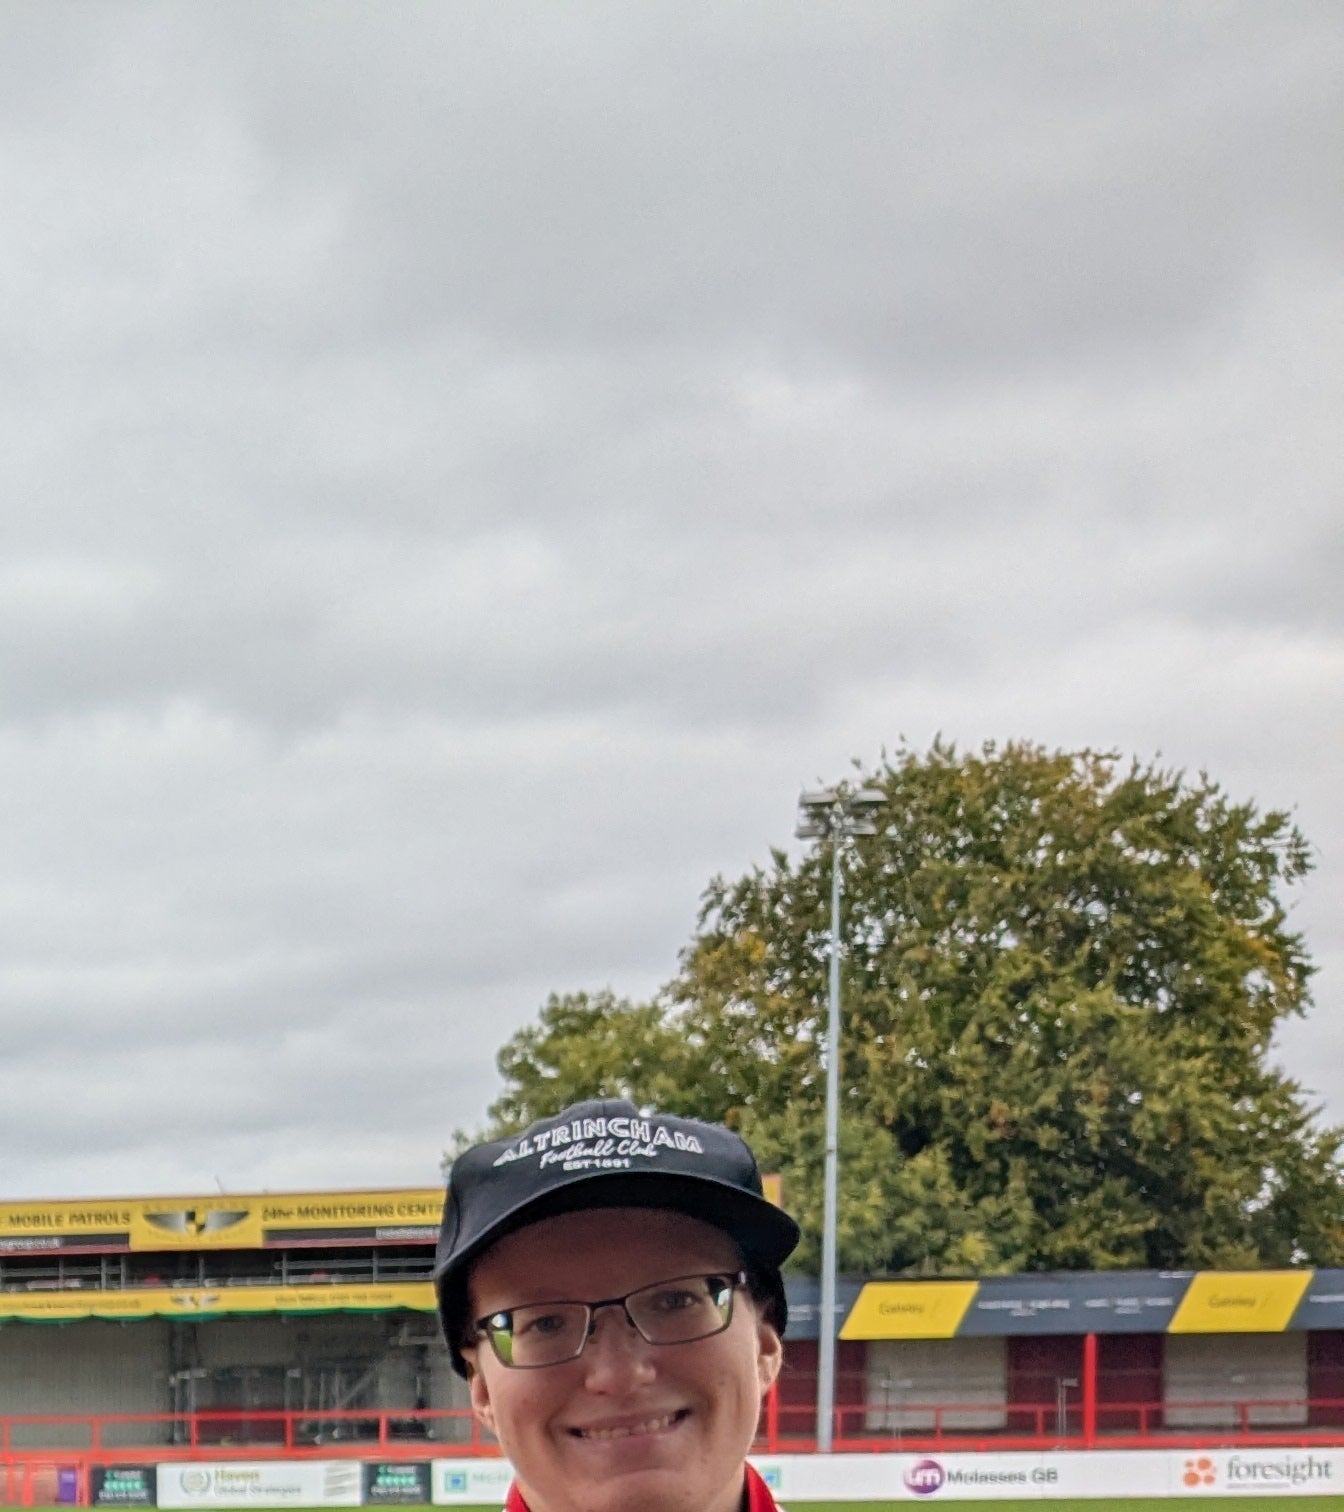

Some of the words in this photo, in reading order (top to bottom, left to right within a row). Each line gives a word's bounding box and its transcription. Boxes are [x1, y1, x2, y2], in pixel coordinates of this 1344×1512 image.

[494, 1117, 704, 1167] ALTRINCHAM
[540, 1139, 613, 1169] Football
[615, 1139, 659, 1158] Club
[8, 1213, 63, 1228] MOBILE
[68, 1211, 131, 1227] PATROLS
[296, 1204, 394, 1219] MONITORING
[947, 1468, 1027, 1484] Molasses
[1031, 1466, 1059, 1485] GB
[1227, 1454, 1332, 1486] foresight
